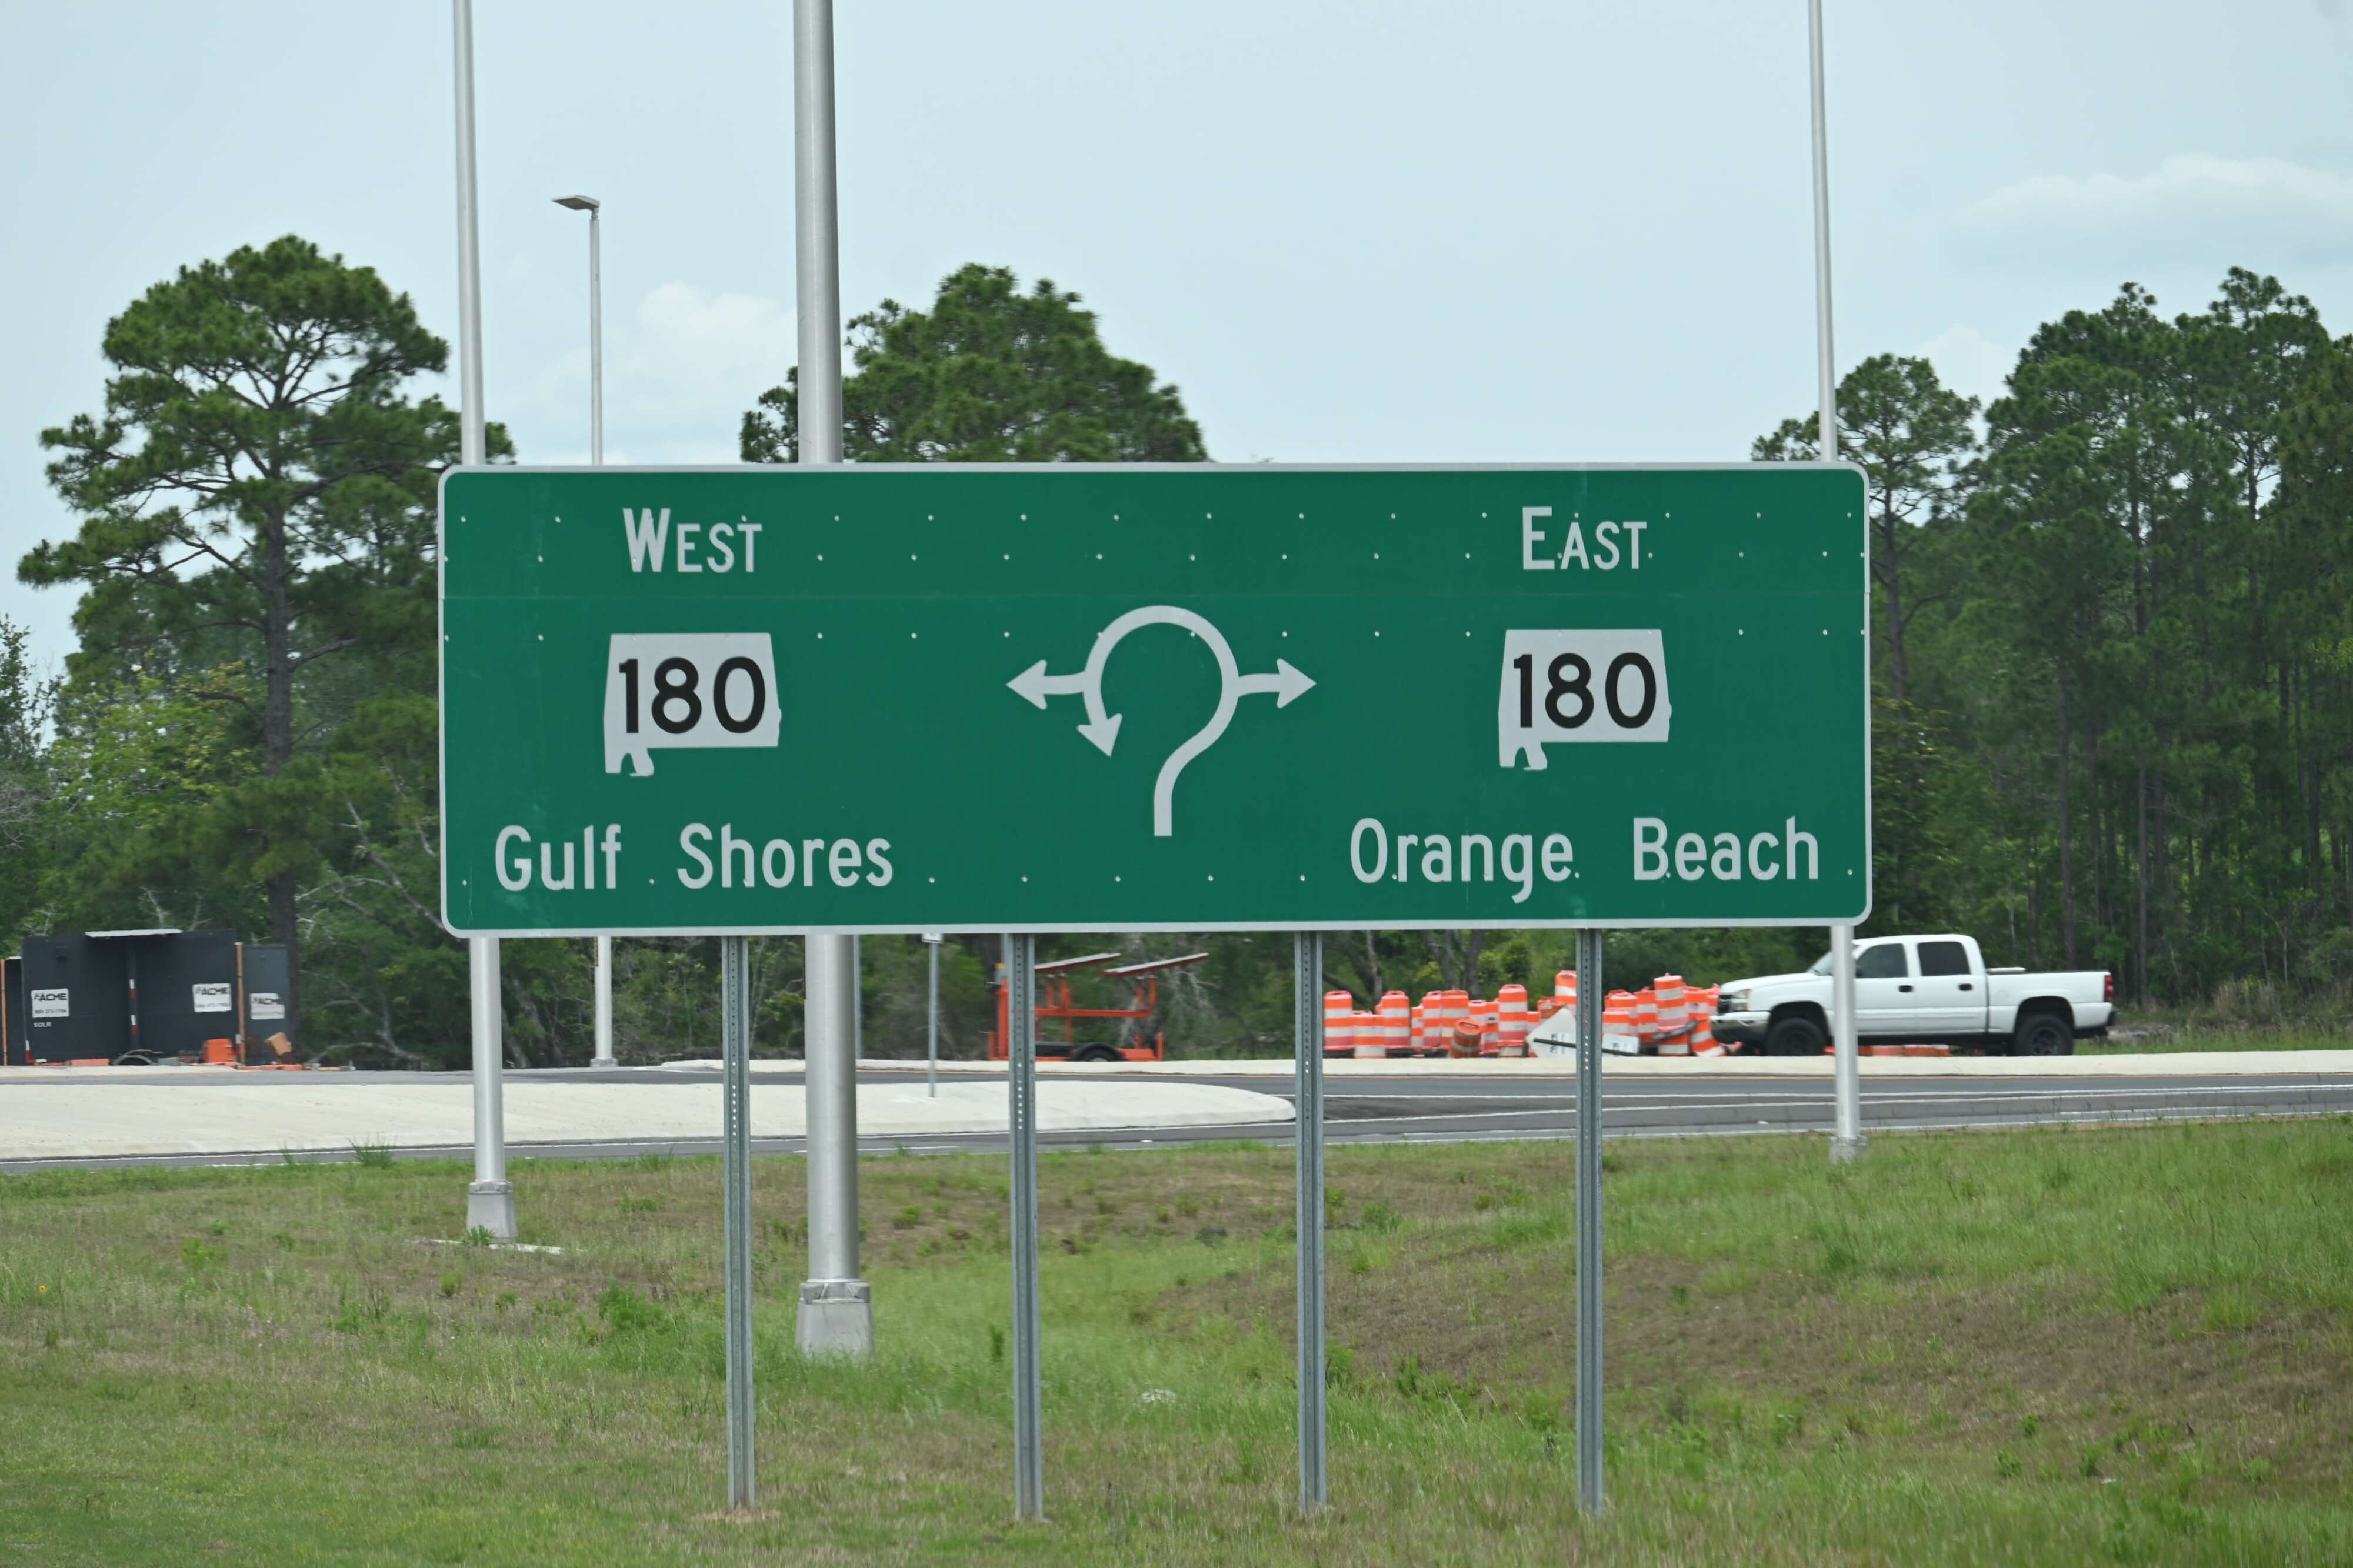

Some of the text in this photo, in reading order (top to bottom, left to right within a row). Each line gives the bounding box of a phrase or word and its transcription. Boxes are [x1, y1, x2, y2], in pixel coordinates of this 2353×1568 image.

[624, 509, 762, 572] WEST
[1522, 507, 1647, 570] EAST
[619, 657, 765, 734] 180
[1514, 652, 1657, 728] 180
[495, 823, 893, 891] Gulf Shores
[1351, 816, 1818, 903] Orange Beach
